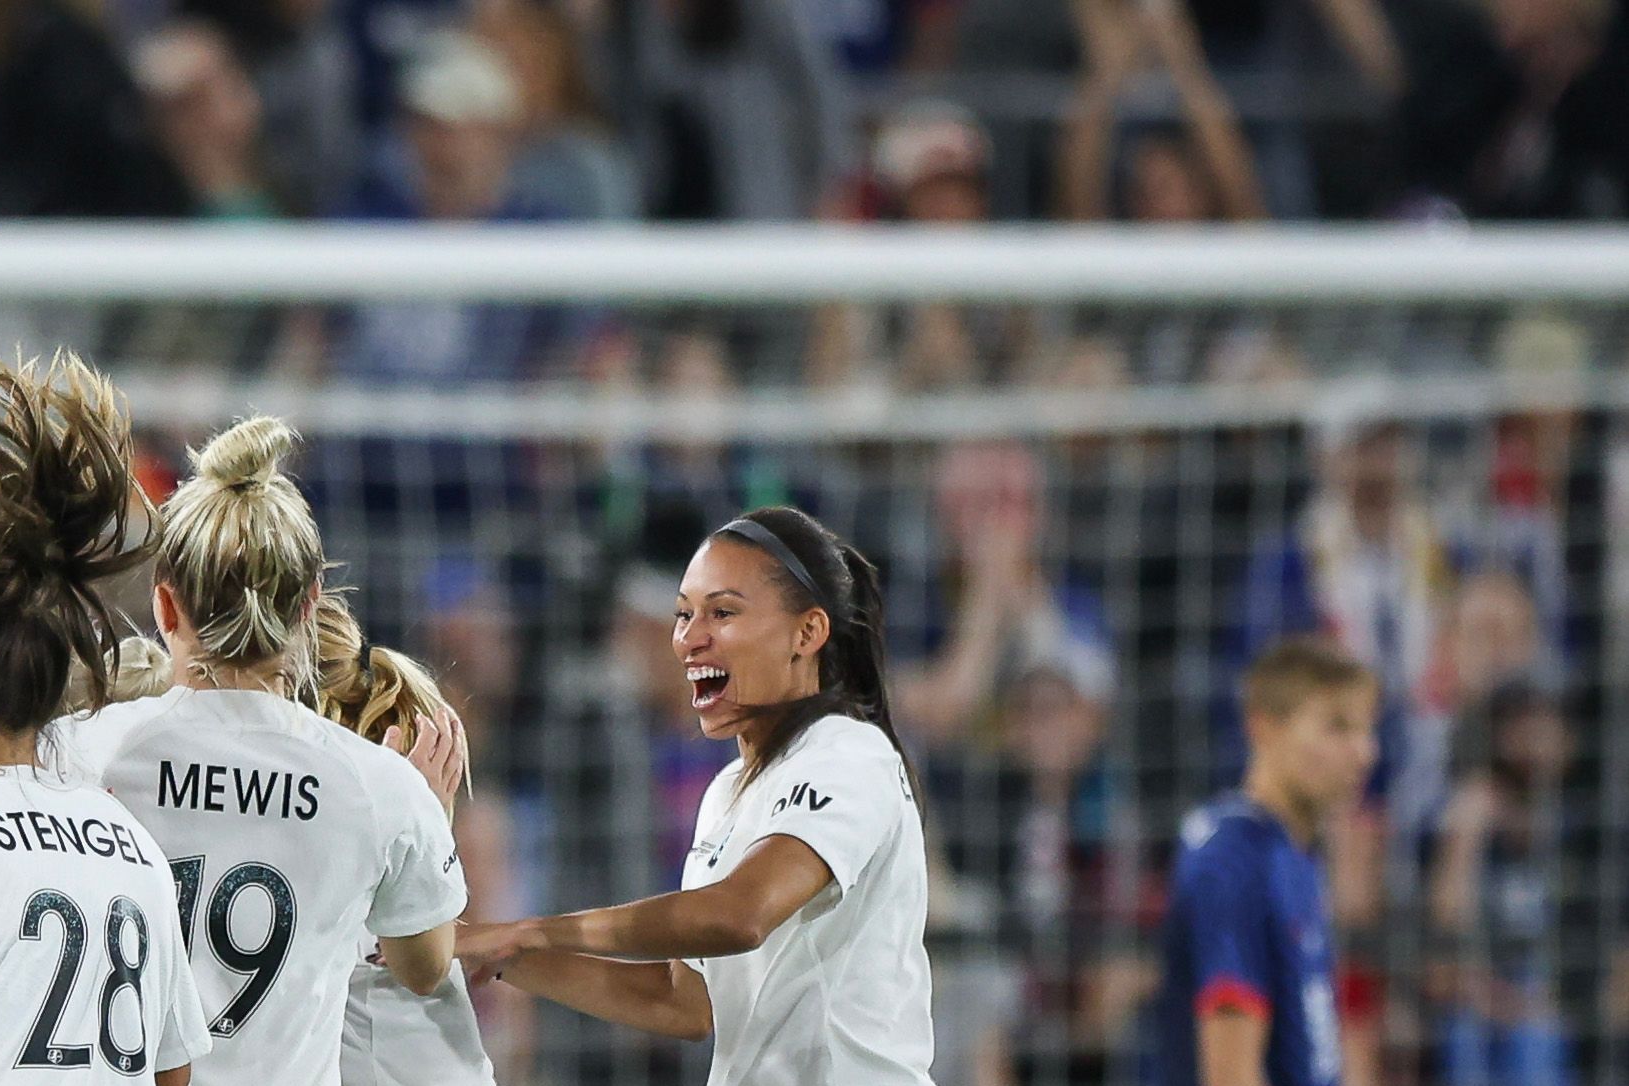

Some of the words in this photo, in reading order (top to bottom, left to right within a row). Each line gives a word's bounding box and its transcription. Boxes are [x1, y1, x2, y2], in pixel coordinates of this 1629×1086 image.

[157, 760, 320, 821] MEWIS
[13, 888, 149, 1077] 28
[167, 854, 299, 1039] 19
